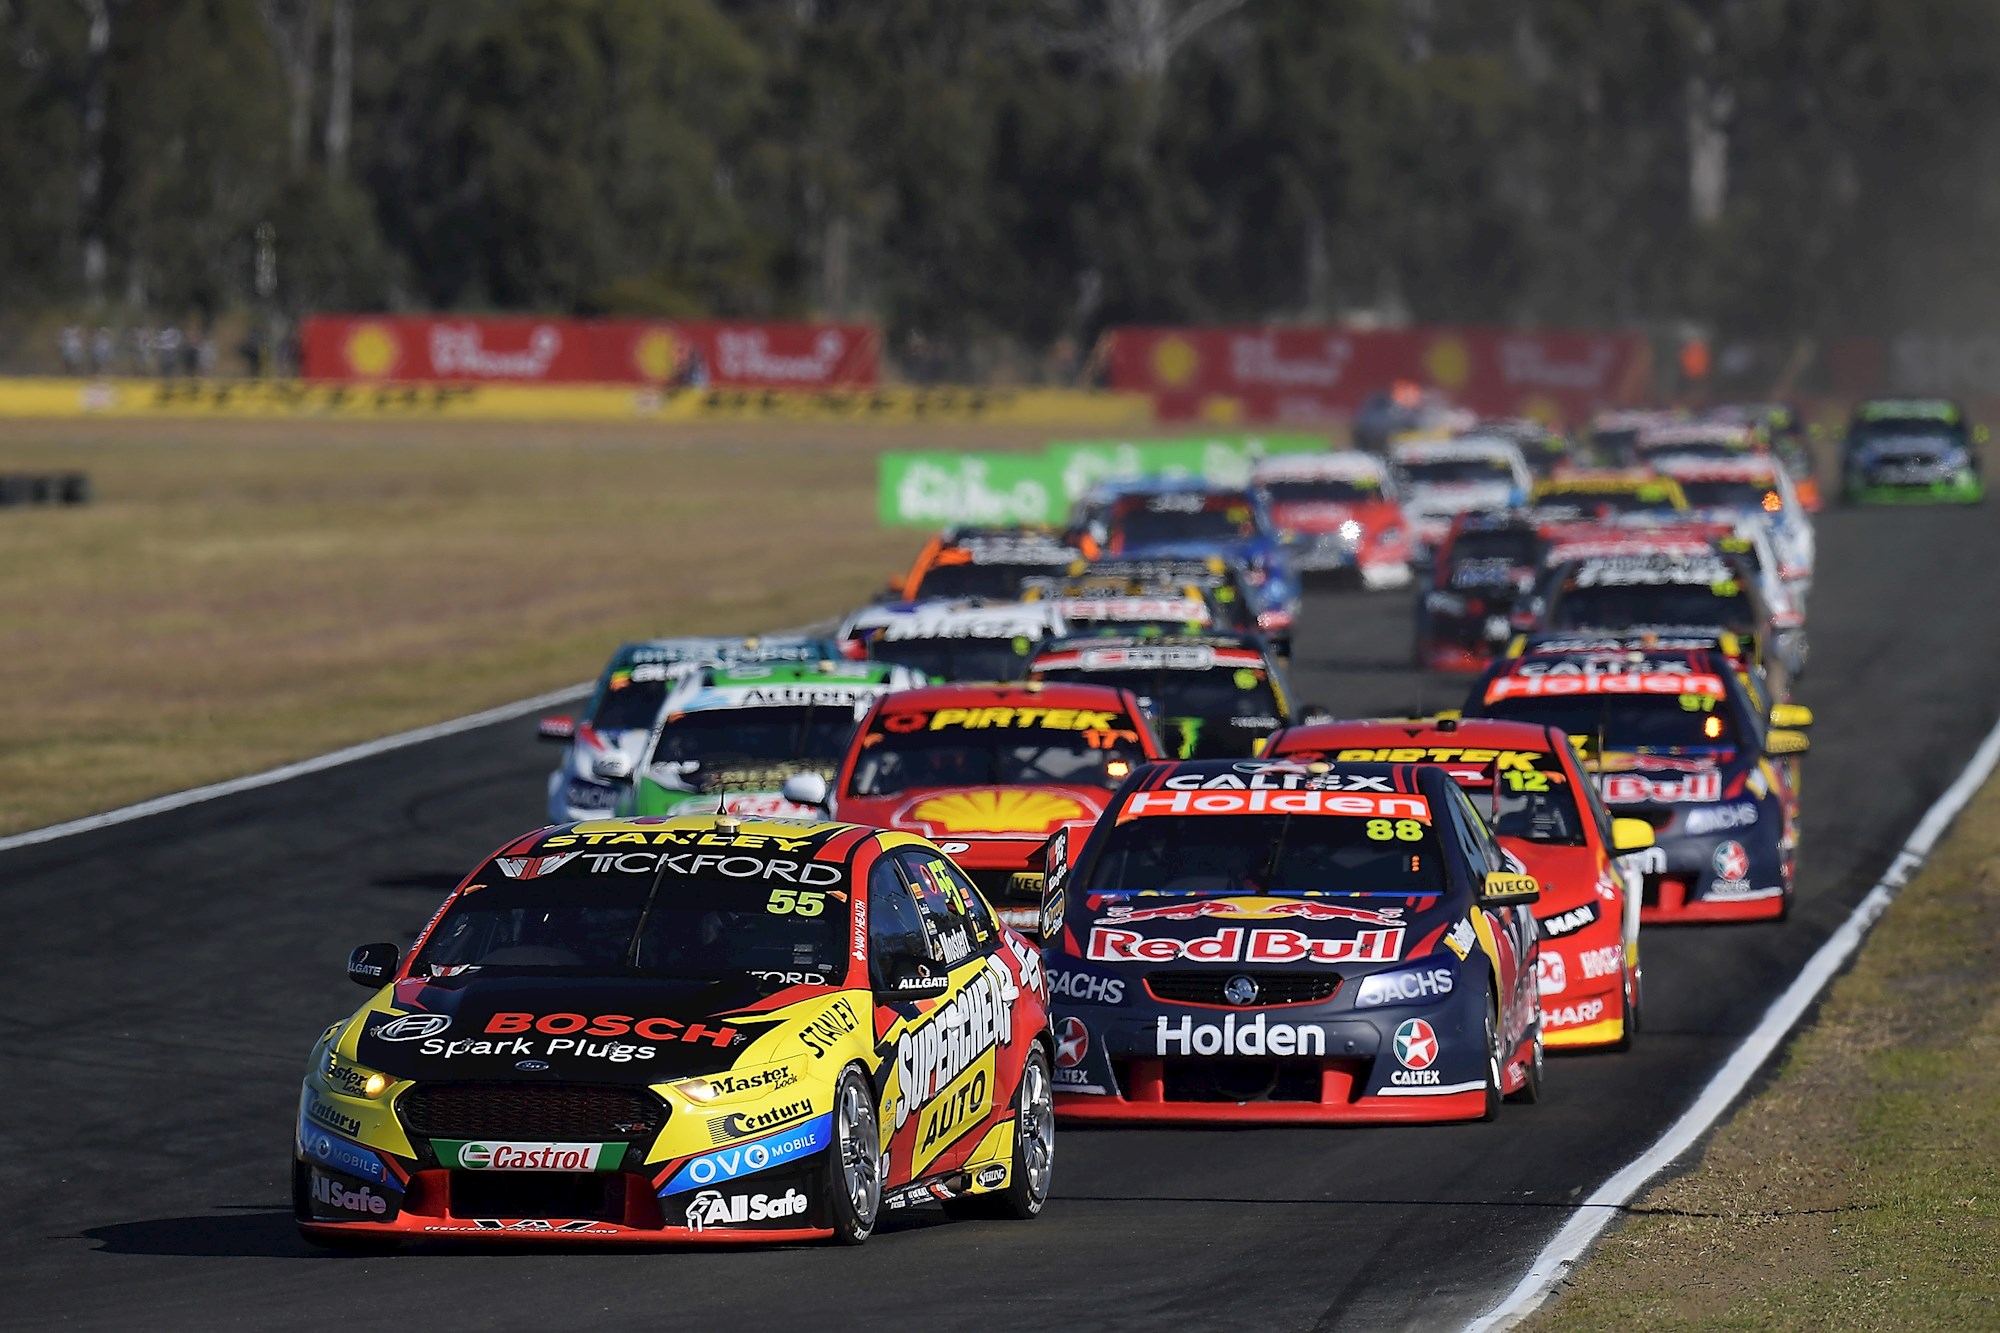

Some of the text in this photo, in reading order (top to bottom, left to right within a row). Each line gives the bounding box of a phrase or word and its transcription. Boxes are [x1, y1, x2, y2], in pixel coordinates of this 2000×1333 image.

[1491, 674, 1722, 694] Holden
[930, 707, 1118, 731] PIRTEK
[1165, 773, 1395, 792] CALTEX
[1502, 769, 1551, 792] 12
[1603, 776, 1722, 802] Bull
[1127, 788, 1428, 816] Holden
[542, 832, 813, 853] STANLEY
[1365, 819, 1424, 841] 88
[581, 852, 843, 886] TICKFORD
[927, 859, 966, 916] 55
[1011, 877, 1043, 890] IVEC
[1488, 879, 1535, 894] IVECO
[765, 888, 826, 918] 55
[854, 899, 866, 952] NAVY HEALTH
[1543, 905, 1596, 936] MAN
[938, 923, 971, 964] Mostert
[1084, 927, 1245, 963] Red
[1245, 927, 1407, 964] Bull
[348, 964, 382, 977] LLGATE
[898, 976, 949, 991] ALLGATE
[1046, 969, 1126, 1004] SACHS
[1364, 968, 1454, 1005] SACHS
[1540, 998, 1603, 1029] HARP
[483, 1012, 738, 1048] BOSCH
[799, 997, 861, 1060] STANLEY
[896, 952, 1020, 1131] SUPERCHEAP
[1155, 1012, 1326, 1057] Holden
[419, 1037, 657, 1063] Spark Plugs
[330, 1061, 369, 1088] aster
[709, 1065, 789, 1097] Master
[774, 1073, 799, 1091] Lock
[1051, 1068, 1089, 1085] ALTEX
[1390, 1069, 1440, 1086] CALTEX
[723, 1098, 814, 1139] Century
[920, 1068, 987, 1156] AUTO
[332, 1149, 379, 1175] MOBILE
[492, 1145, 591, 1169] Castrol
[689, 1132, 817, 1184] OVO MOBILE
